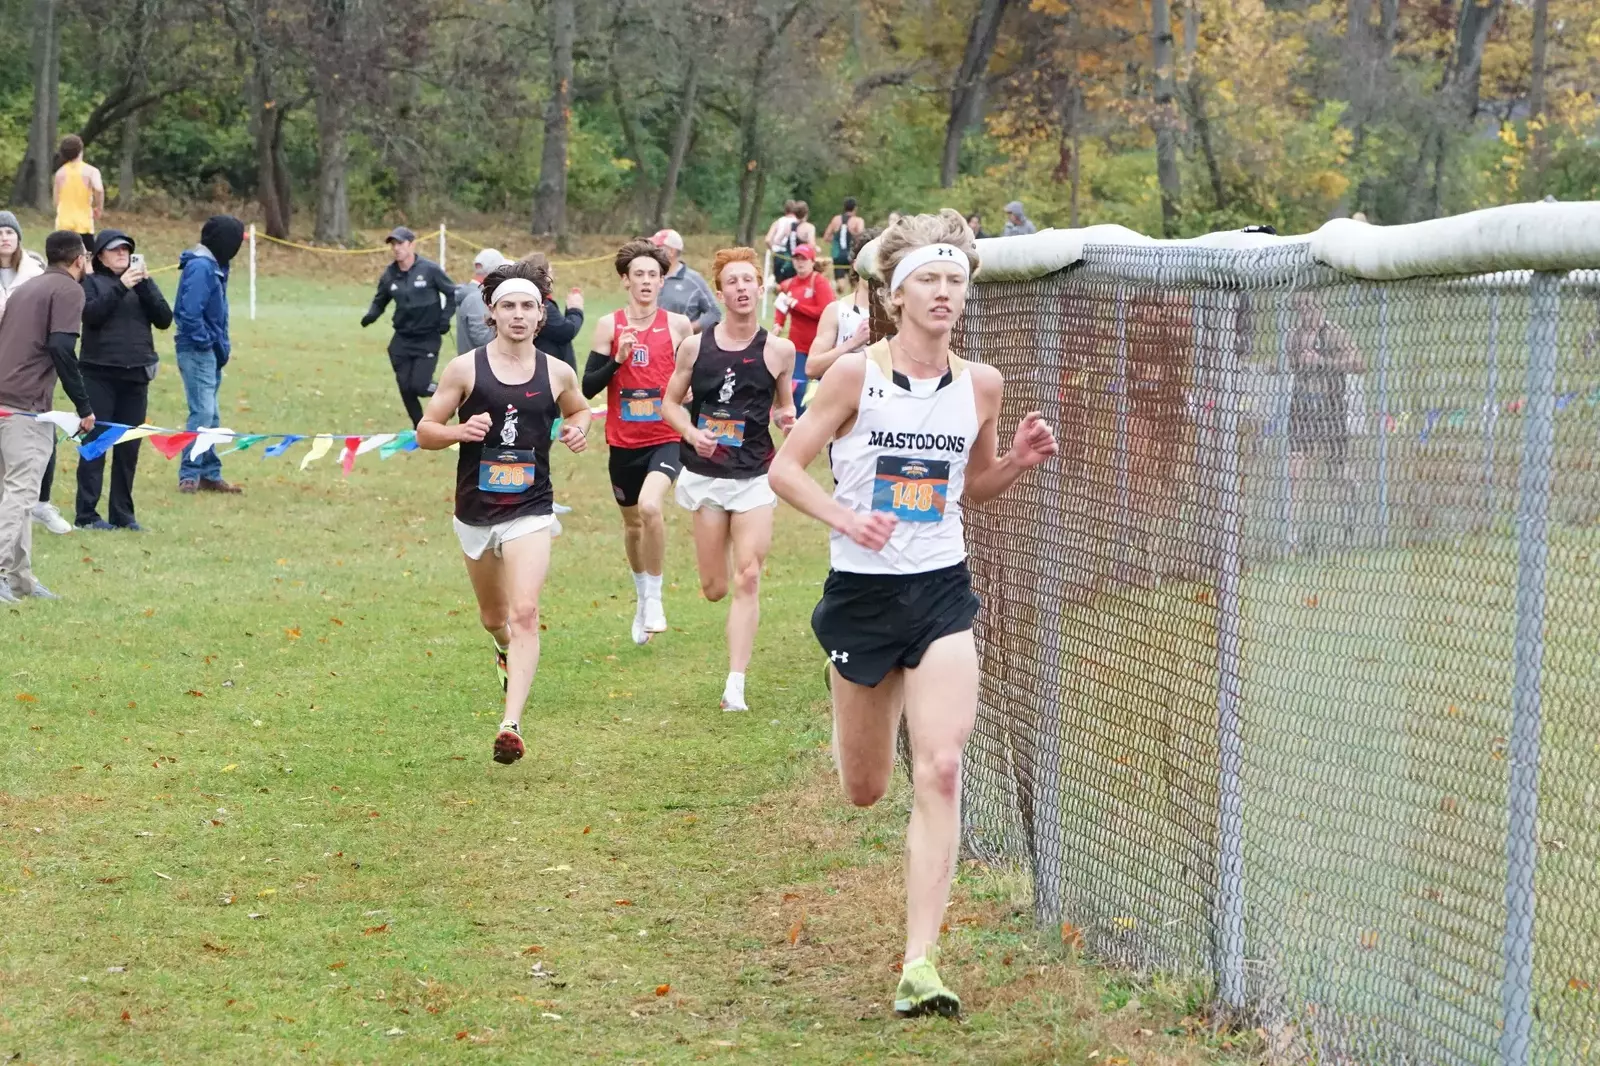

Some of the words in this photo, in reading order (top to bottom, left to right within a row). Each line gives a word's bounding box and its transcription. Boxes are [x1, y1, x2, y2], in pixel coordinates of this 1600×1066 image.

[868, 431, 965, 453] MASTODONS
[489, 465, 524, 487] 236
[891, 482, 933, 511] 148
